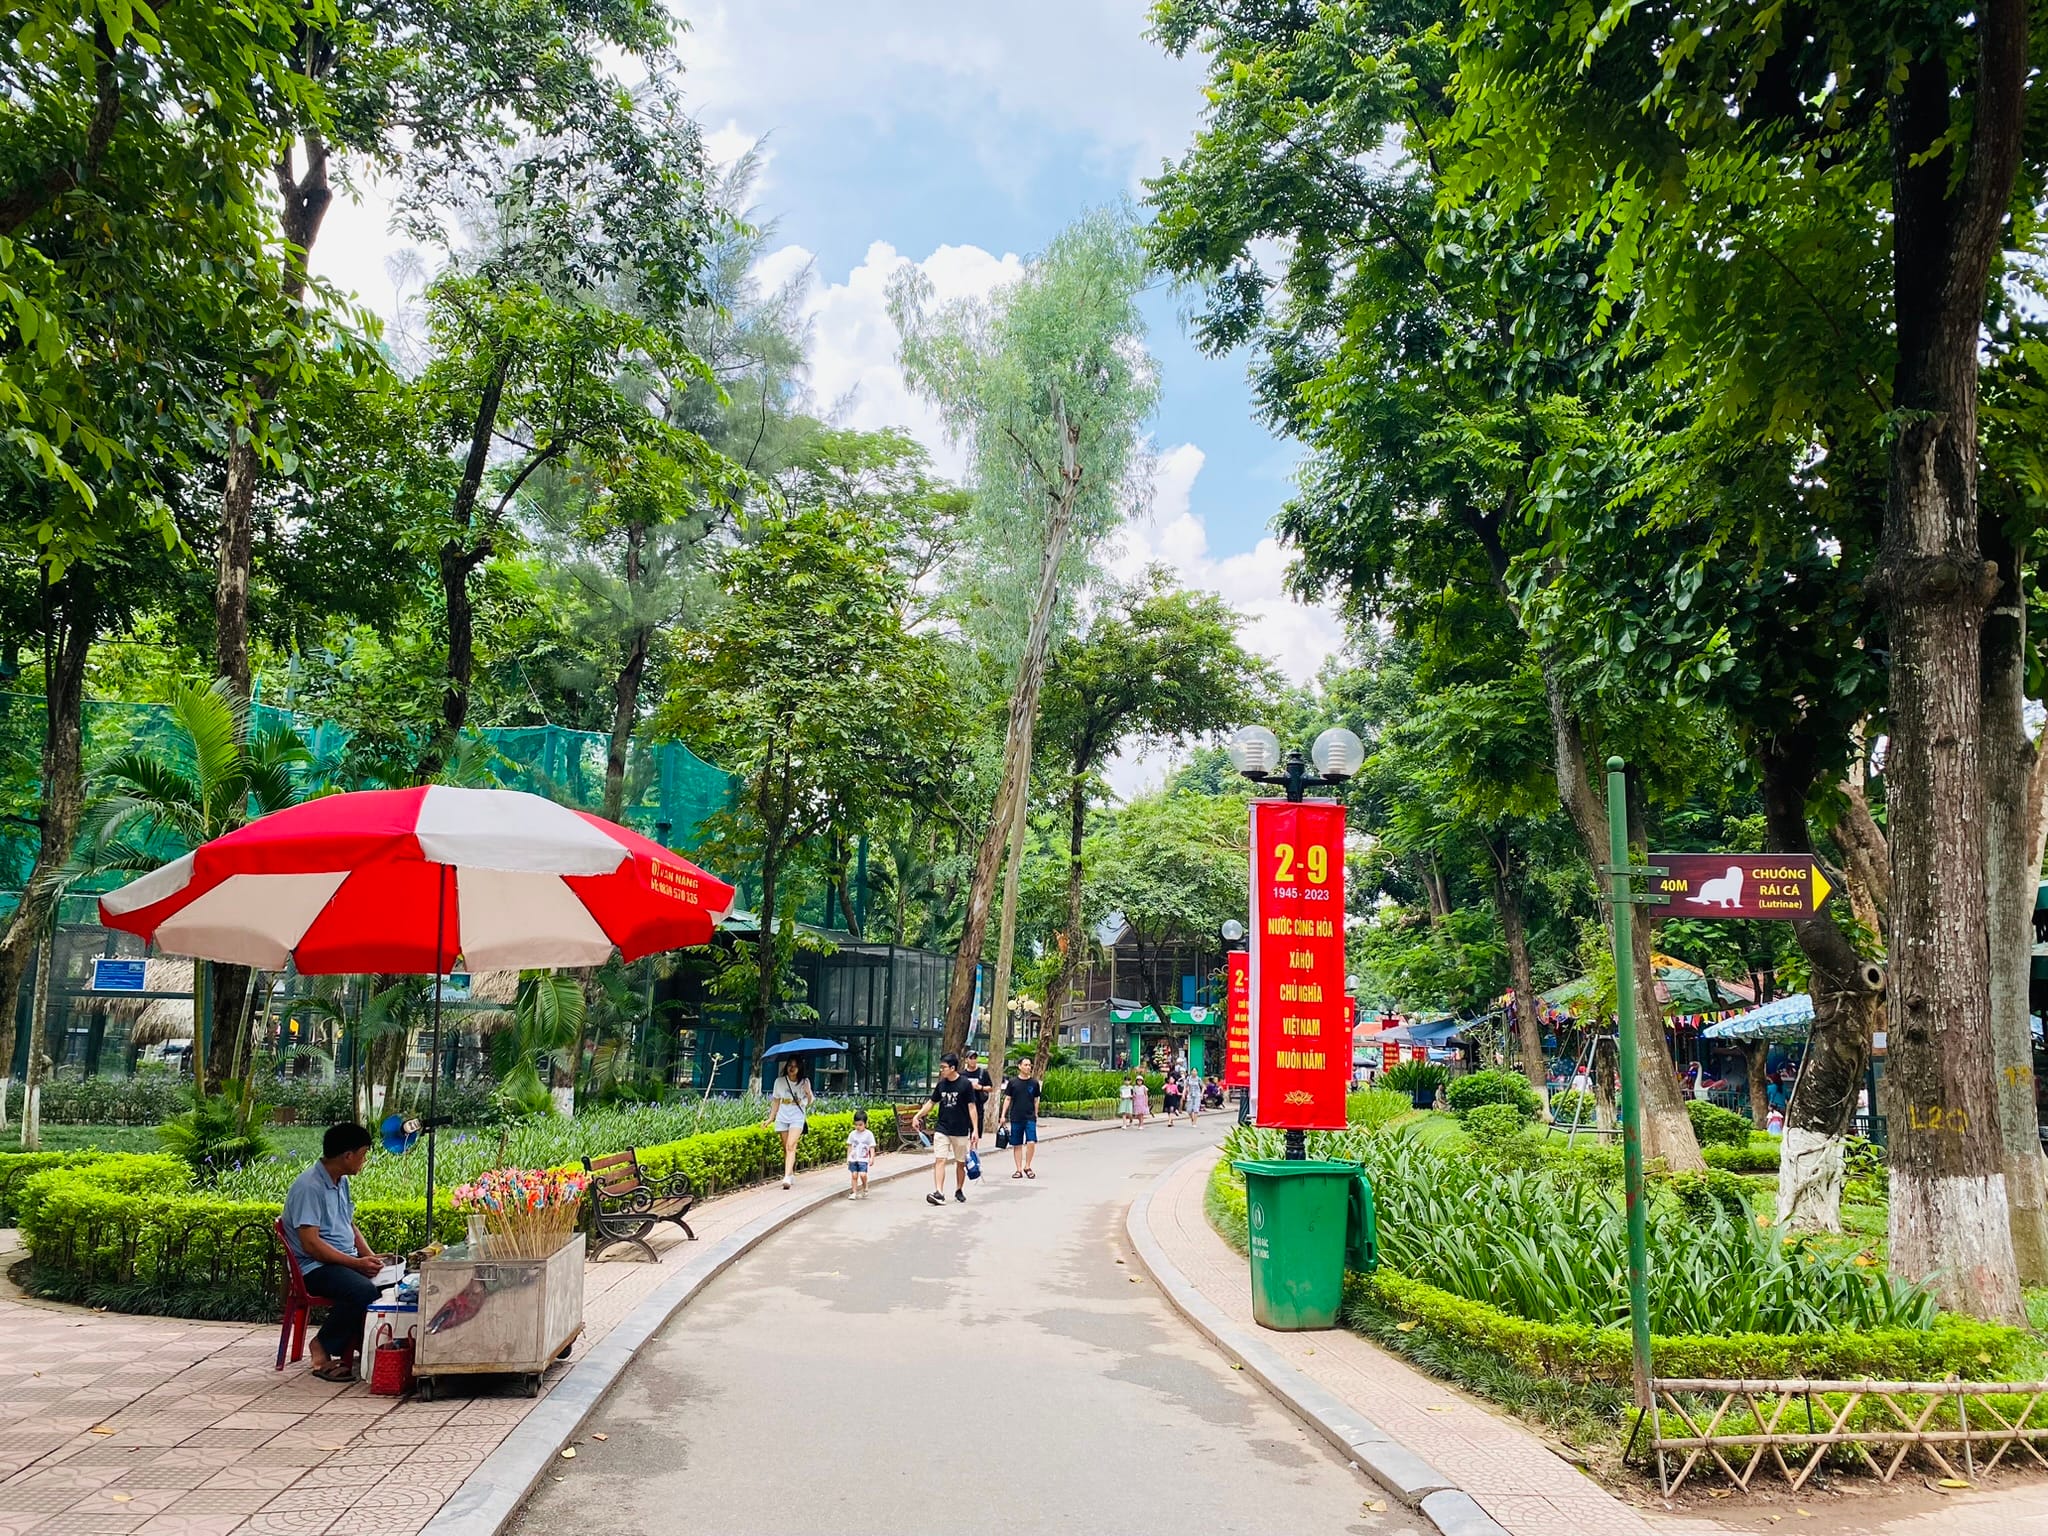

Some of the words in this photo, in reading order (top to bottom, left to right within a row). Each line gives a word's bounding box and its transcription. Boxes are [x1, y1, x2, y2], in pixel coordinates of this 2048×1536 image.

[1274, 843, 1328, 884] 2-9
[1273, 887, 1298, 898] 1945
[1304, 889, 1329, 900] 2023
[1660, 879, 1688, 892] 40M
[1760, 883, 1780, 895] RÁI
[1782, 883, 1800, 896] CÁ
[1758, 899, 1803, 910] (Lutrinae)
[1267, 915, 1293, 936] NƯỚC
[1279, 978, 1298, 1002] CHỦ
[1282, 1014, 1300, 1039] VIỆT
[1300, 1018, 1321, 1036] NAM
[1302, 1049, 1326, 1071] NĂM!
